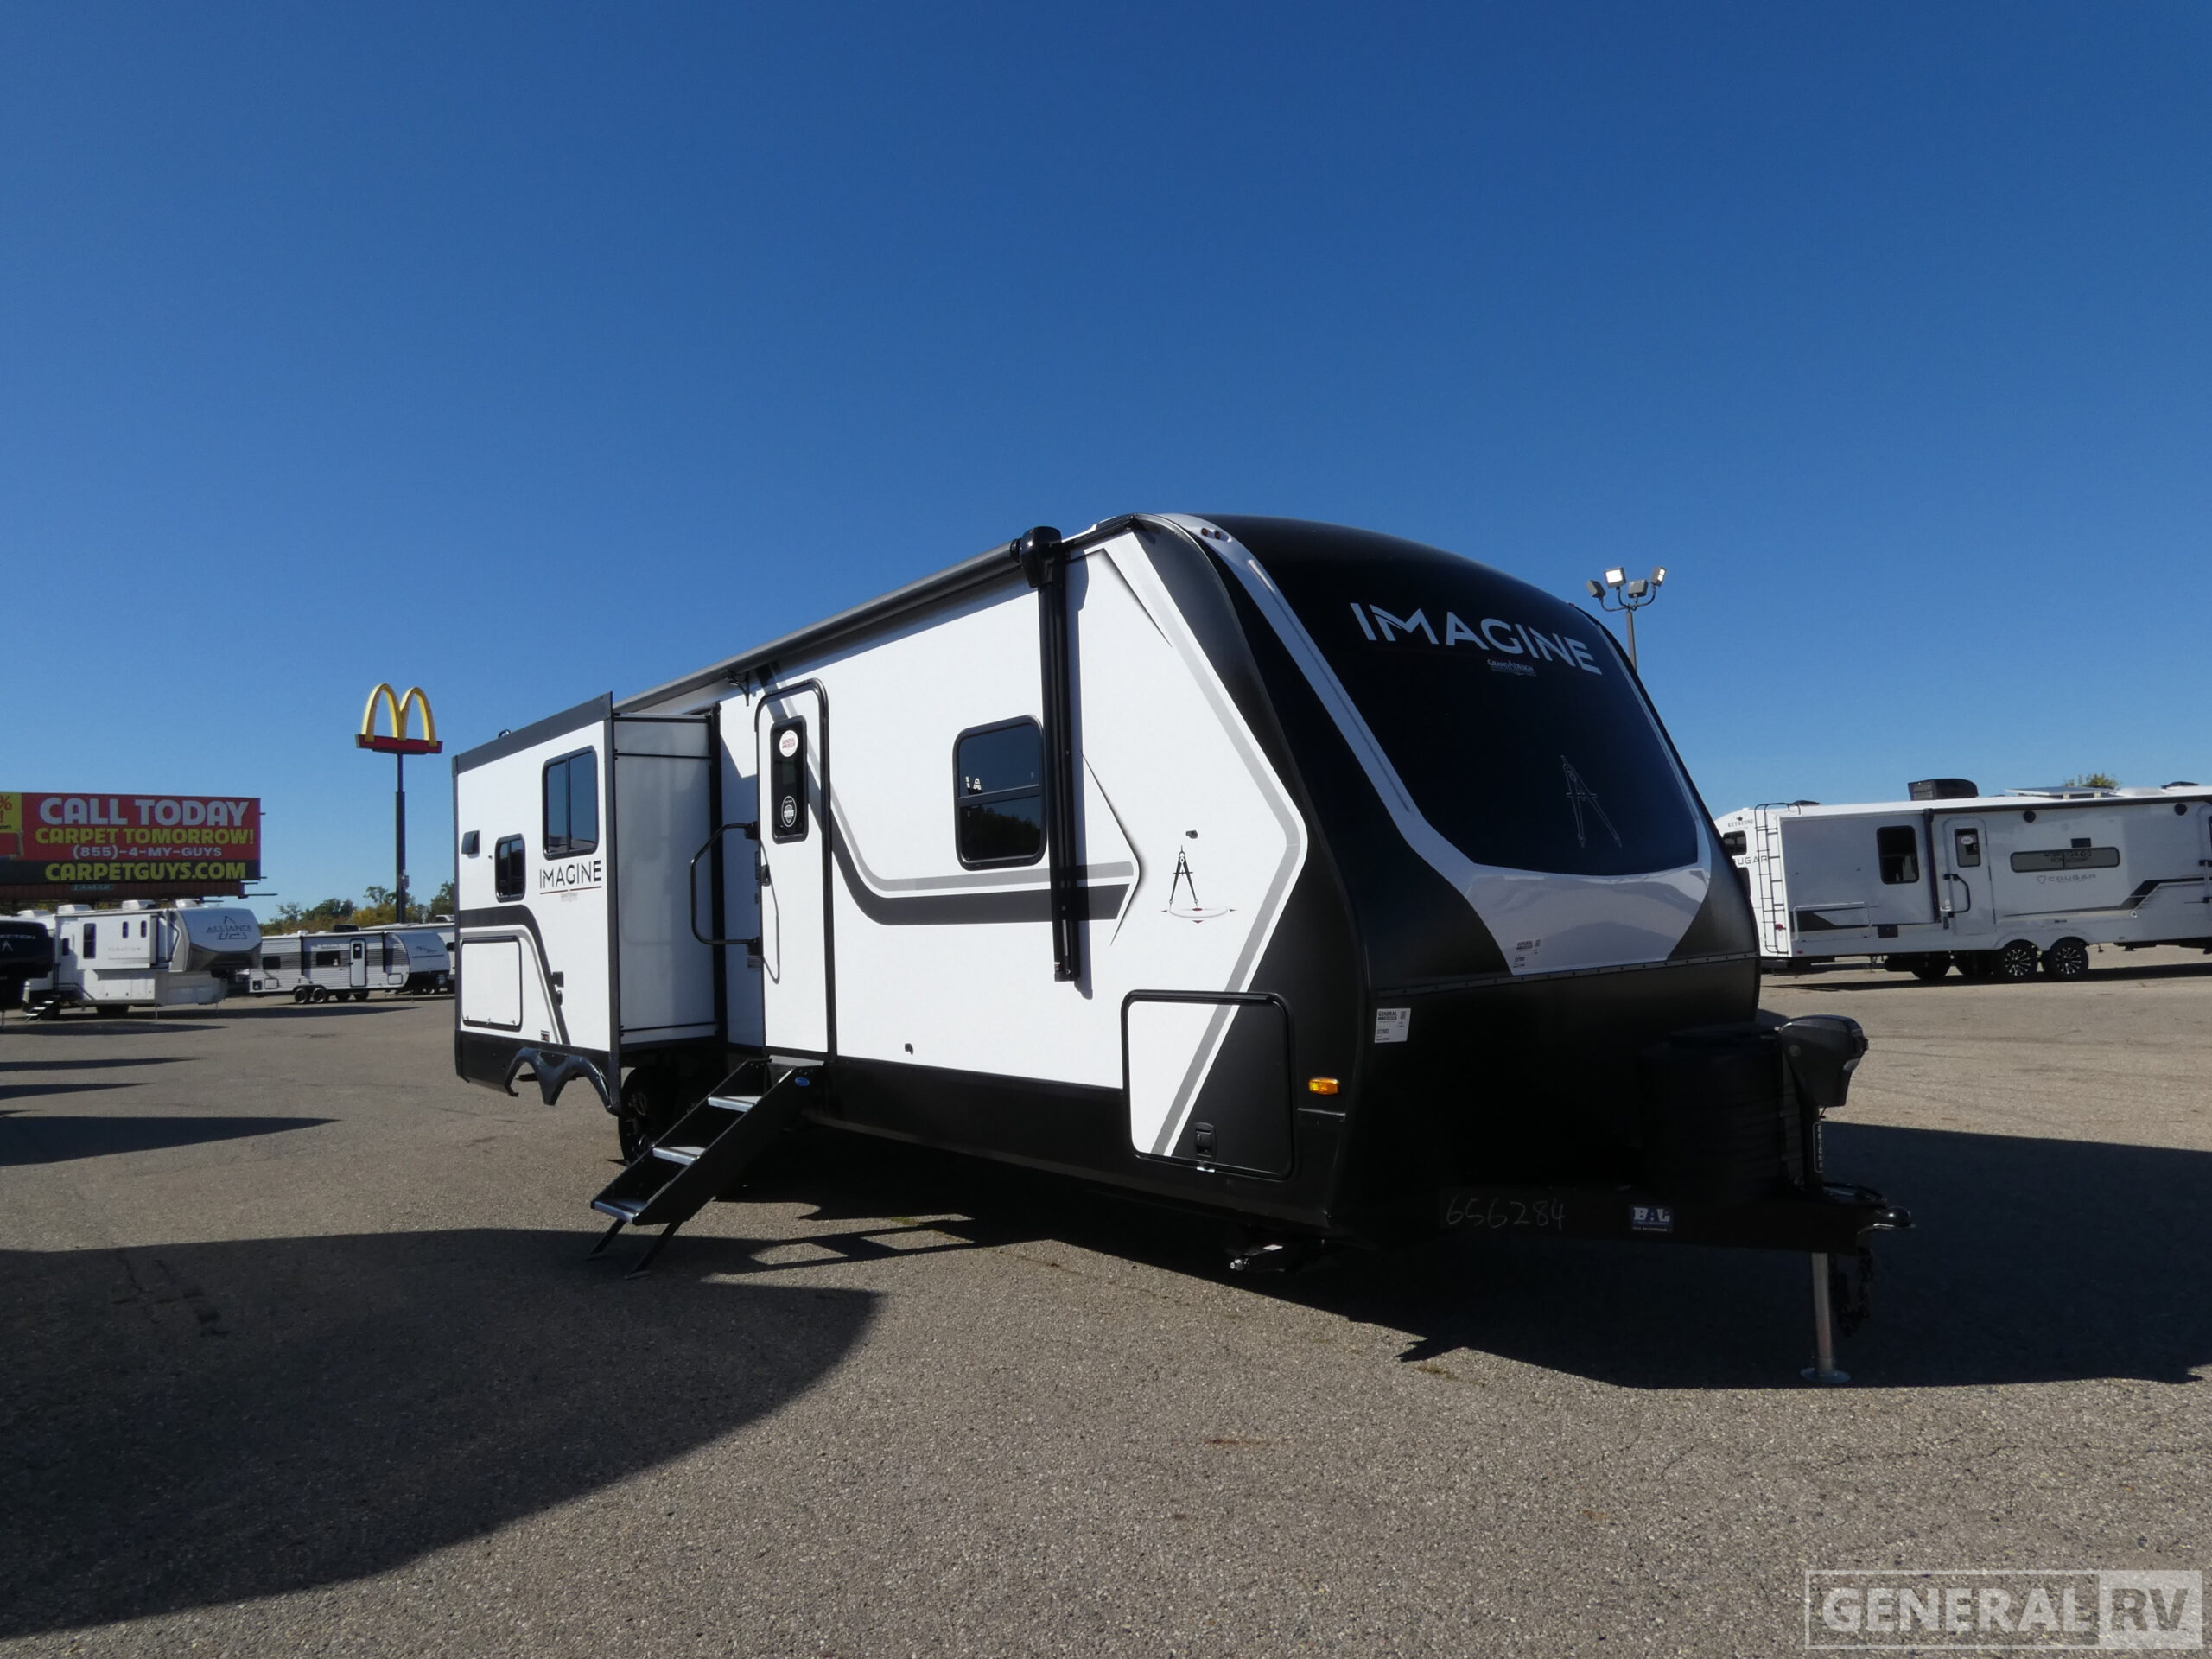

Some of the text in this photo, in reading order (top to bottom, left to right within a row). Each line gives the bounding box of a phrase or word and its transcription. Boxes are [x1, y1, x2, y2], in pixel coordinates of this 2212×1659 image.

[1350, 602, 1603, 676] IMAGINE
[40, 798, 249, 827] CALL TODAY
[35, 828, 254, 845] CARPET TOMORROW!
[73, 844, 223, 860] (855)-4-MY-GUYS
[1733, 855, 1768, 865] UGAR
[45, 862, 246, 881] CARPETGUYS.COM
[539, 861, 602, 889] IMAGINE
[2048, 874, 2097, 882] COUGAR
[207, 925, 251, 933] ALLIANCE
[1446, 1195, 1565, 1230] 656284
